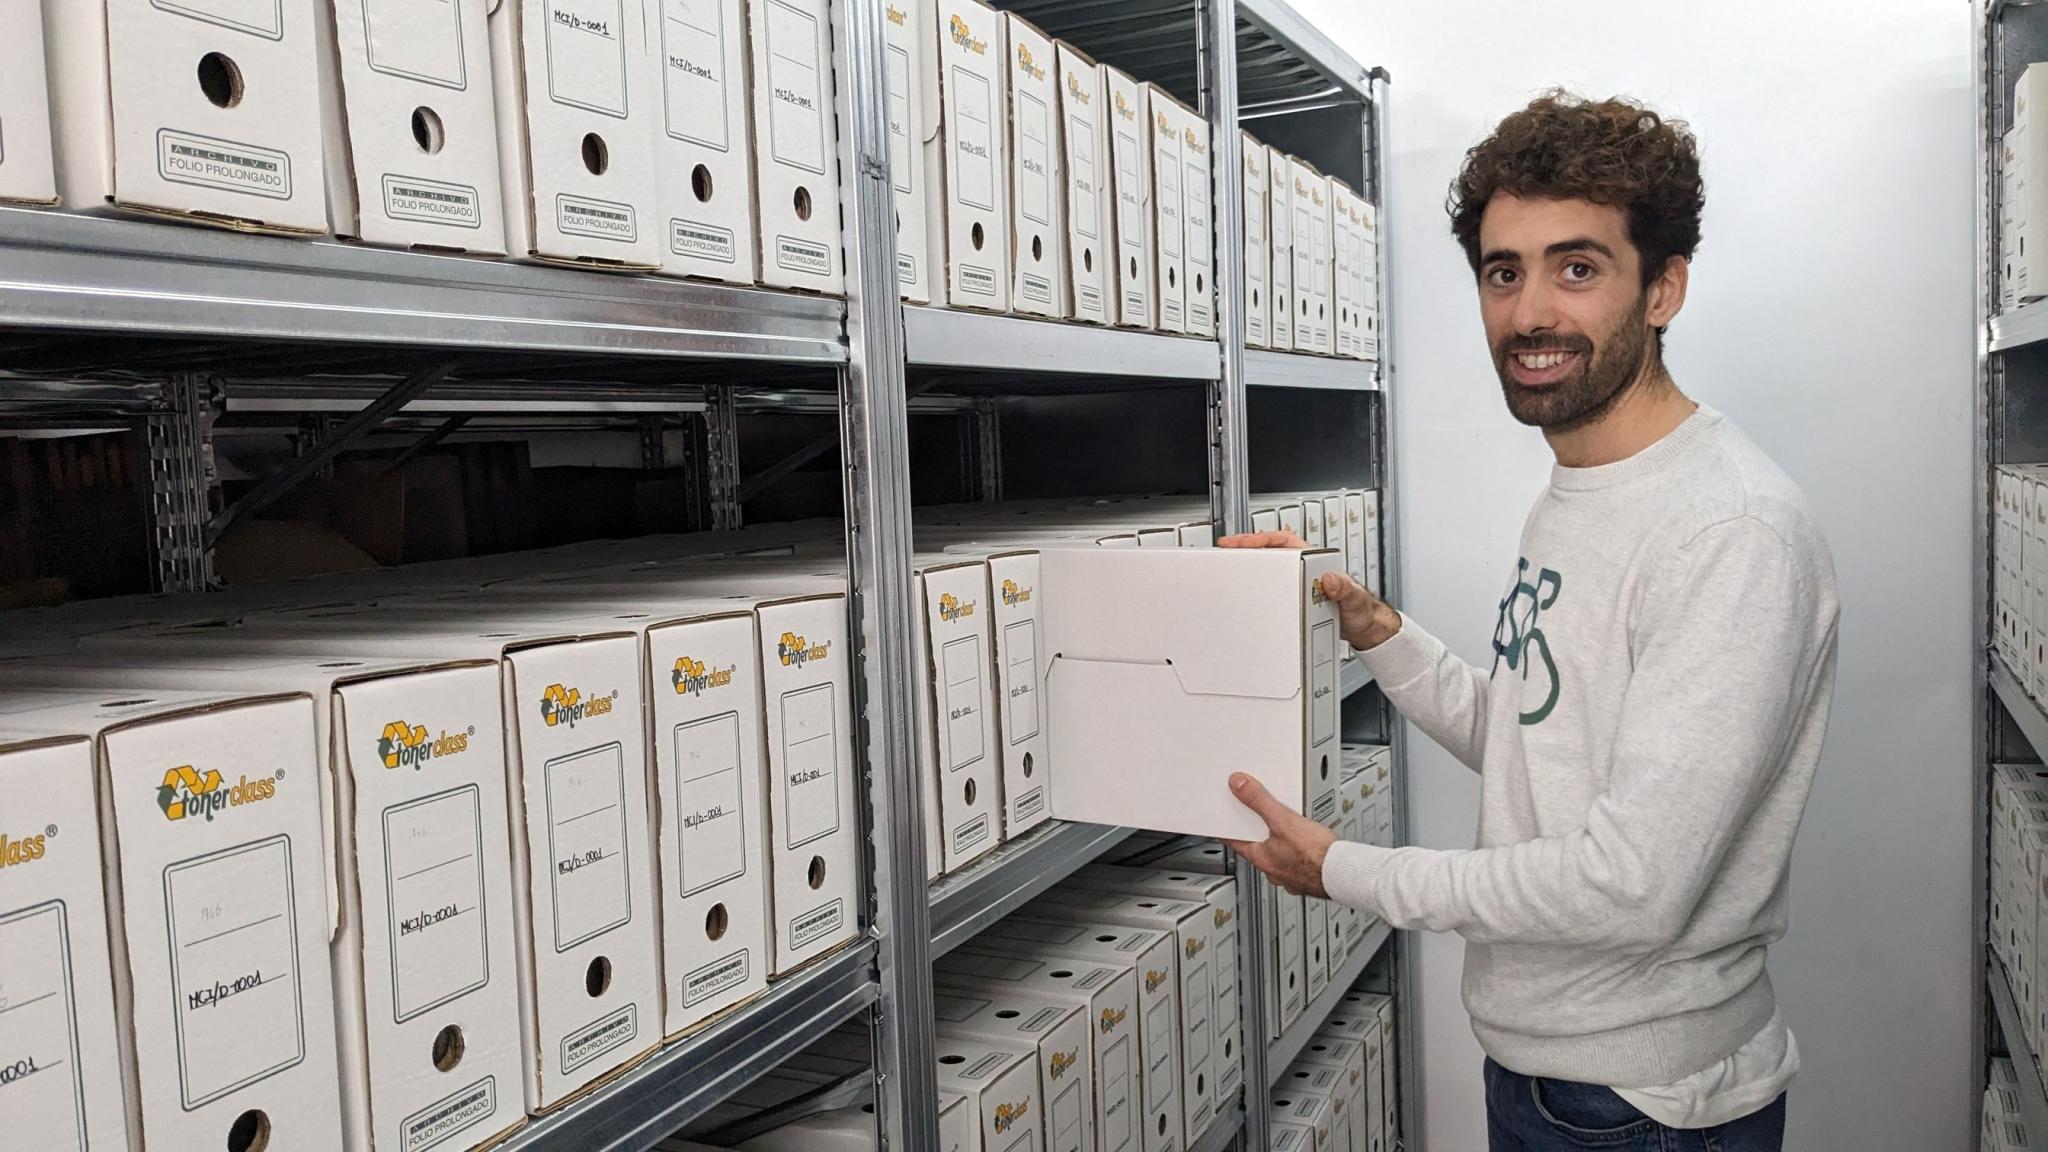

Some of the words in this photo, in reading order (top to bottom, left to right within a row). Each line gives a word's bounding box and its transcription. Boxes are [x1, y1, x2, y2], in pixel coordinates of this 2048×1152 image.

[554, 9, 610, 36] MCI/D-0001
[173, 144, 276, 171] ARCHIVO
[169, 157, 204, 173] FOLIO
[206, 163, 282, 186] PROLONGADO
[392, 198, 418, 211] FOLIO
[419, 201, 473, 217] PROLONGADO
[394, 187, 469, 205] ARCHIVO
[563, 215, 585, 226] FOLIO
[585, 217, 631, 233] PROLONGADO
[188, 969, 262, 1011] MCI/D-0001
[567, 1046, 586, 1063] FOLIO
[587, 1023, 631, 1053] PROLONGADO
[409, 1128, 433, 1148] FOLIO
[434, 1098, 489, 1135] PROLONGADO
